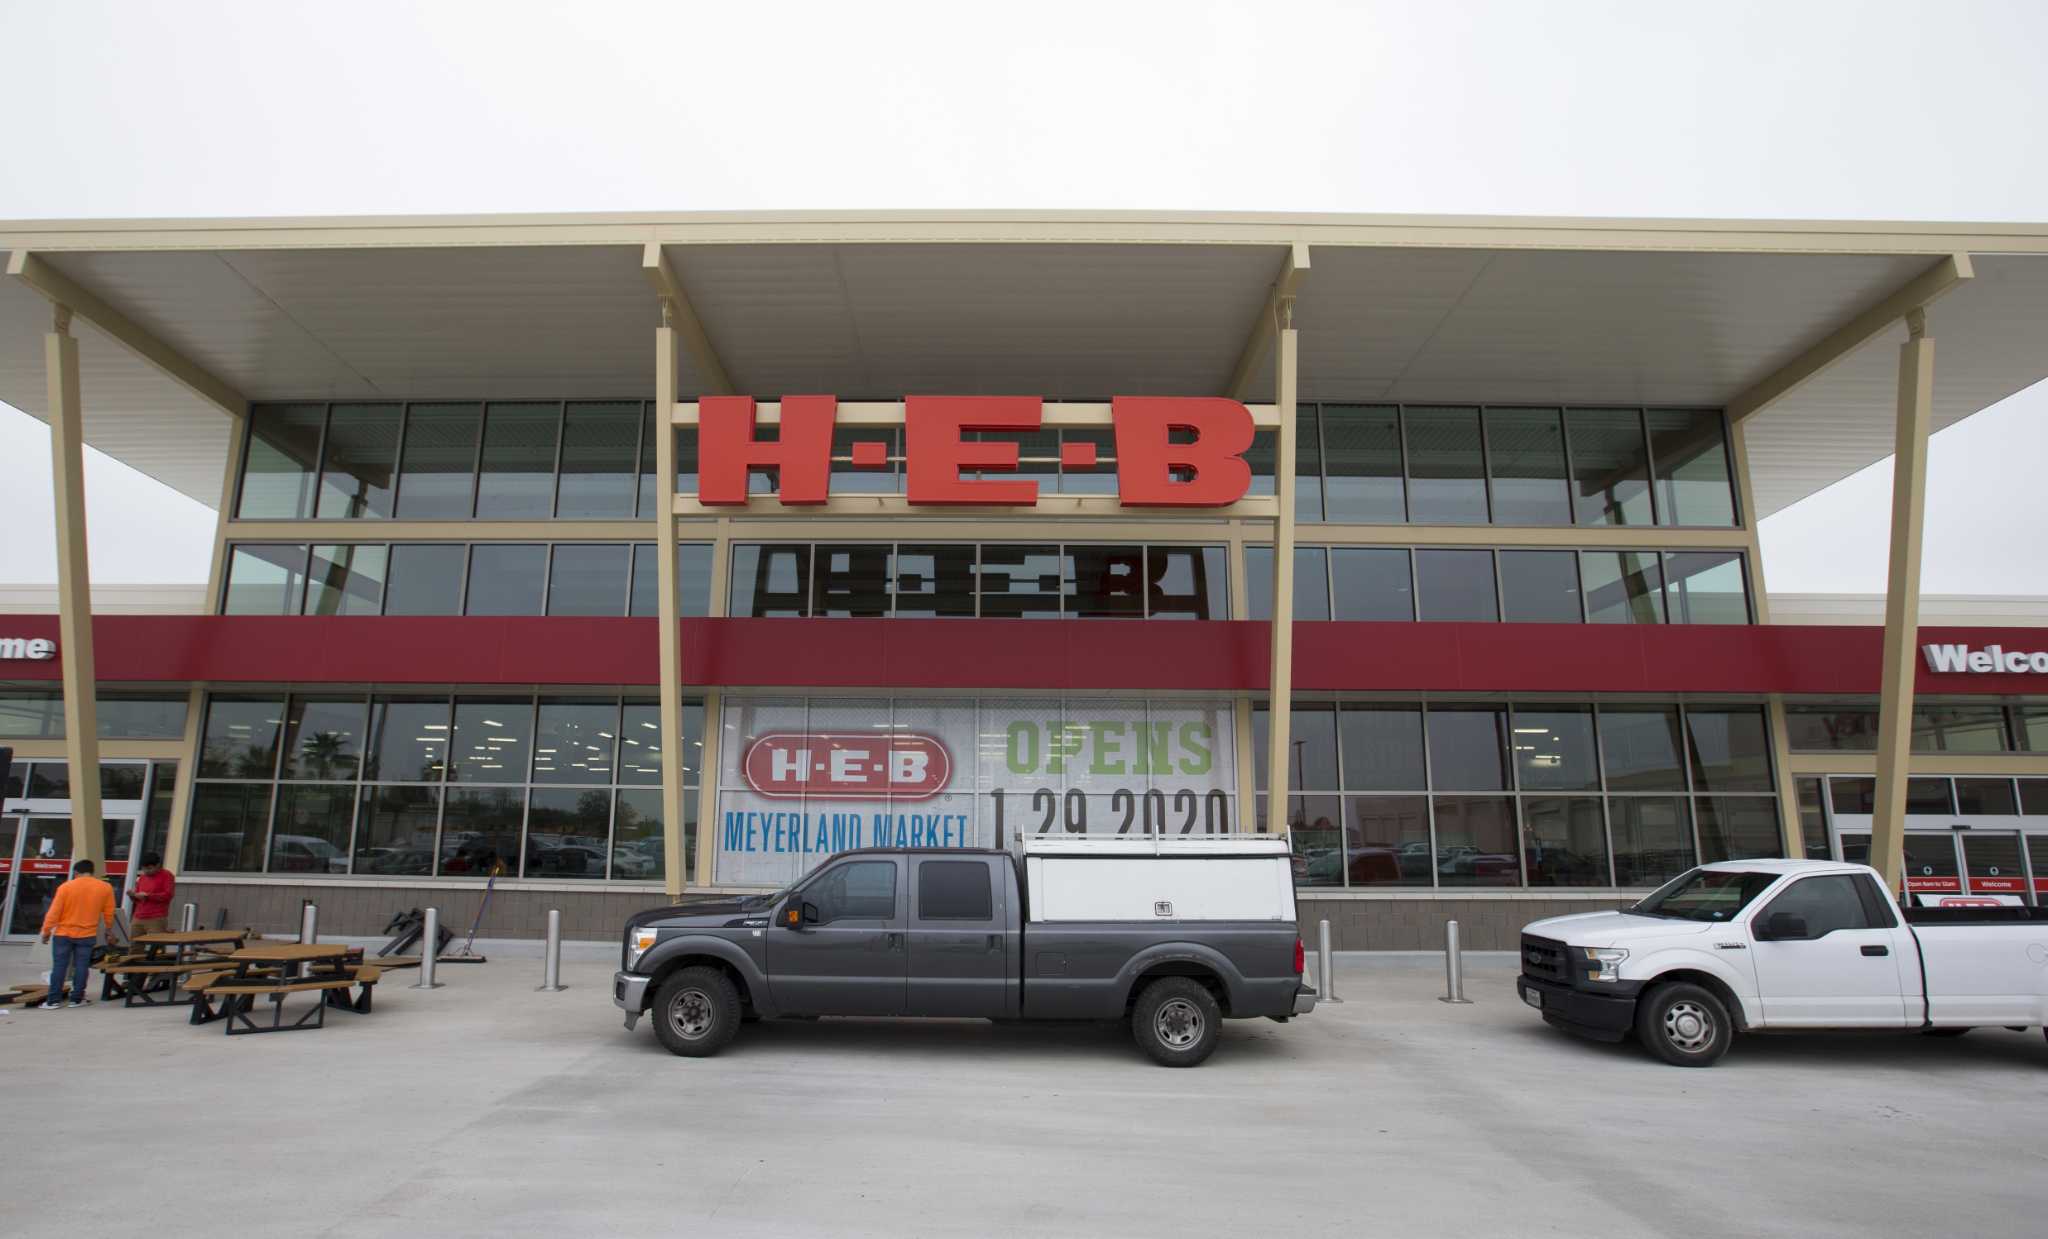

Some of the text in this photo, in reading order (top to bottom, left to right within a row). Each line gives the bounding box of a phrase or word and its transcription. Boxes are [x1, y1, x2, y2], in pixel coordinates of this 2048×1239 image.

[698, 395, 1256, 507] H-E-B
[0, 638, 57, 659] me
[1922, 644, 2048, 673] Welco
[771, 749, 929, 783] H-E-B
[1007, 720, 1212, 775] OPENS
[724, 811, 968, 853] MEYERLAND MARKET
[990, 787, 1229, 849] 1 29 2020
